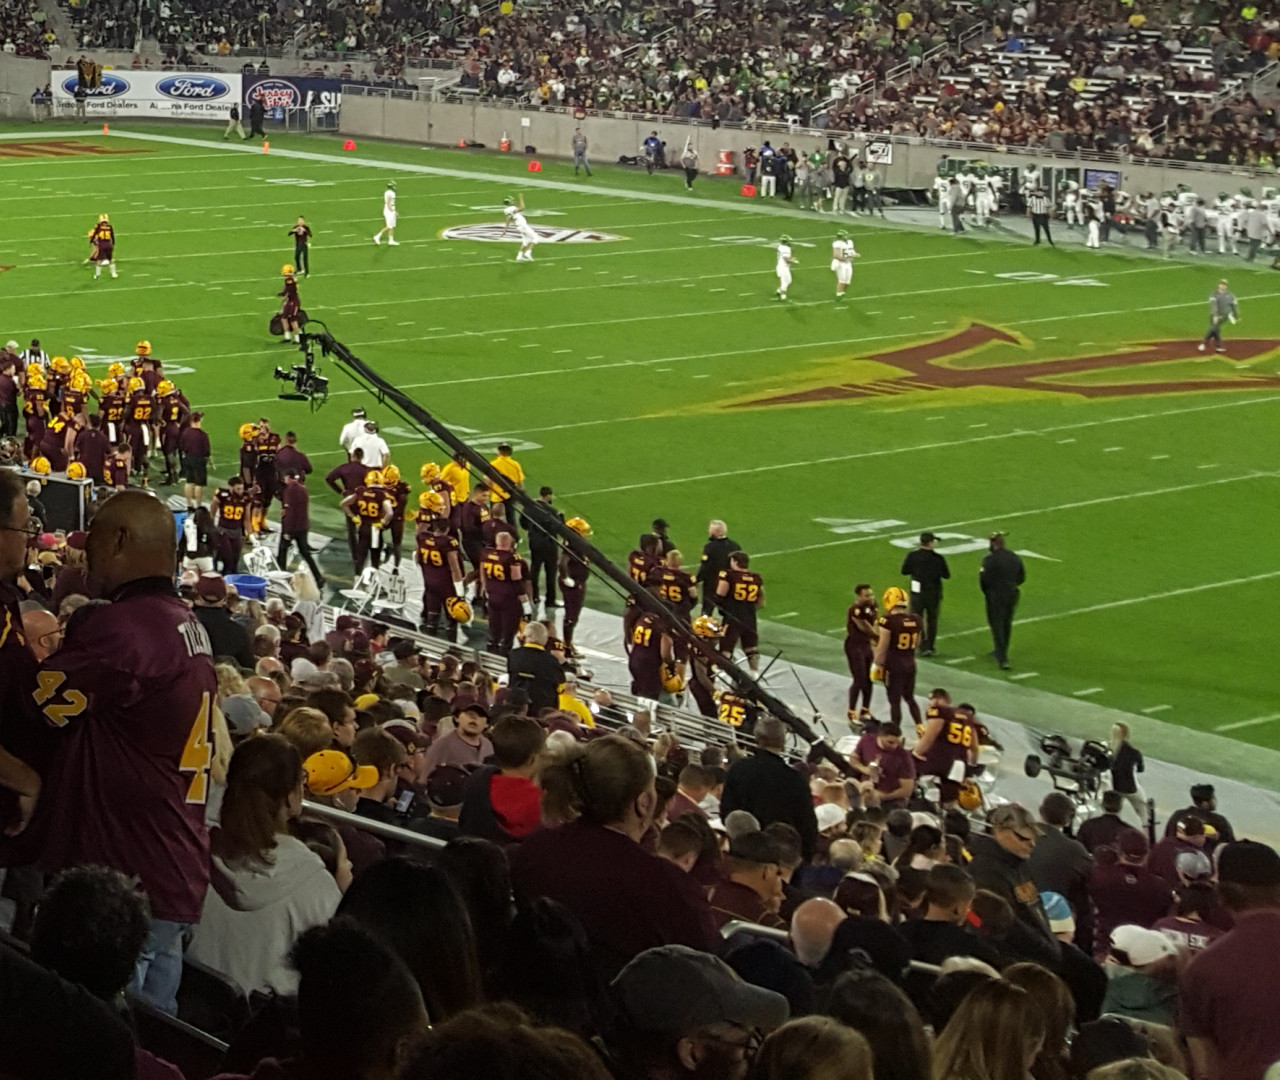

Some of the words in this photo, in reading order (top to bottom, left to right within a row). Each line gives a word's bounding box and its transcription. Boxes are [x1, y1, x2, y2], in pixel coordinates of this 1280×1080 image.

[171, 79, 215, 98] Ford
[87, 101, 105, 109] Ford
[107, 100, 138, 109] Dealers
[184, 103, 203, 111] Ford
[358, 501, 379, 517] 26
[484, 563, 505, 580] 76
[734, 583, 758, 602] 52
[634, 626, 652, 647] 61
[32, 670, 88, 728] 42
[719, 704, 744, 726] 25
[947, 722, 971, 746] 56
